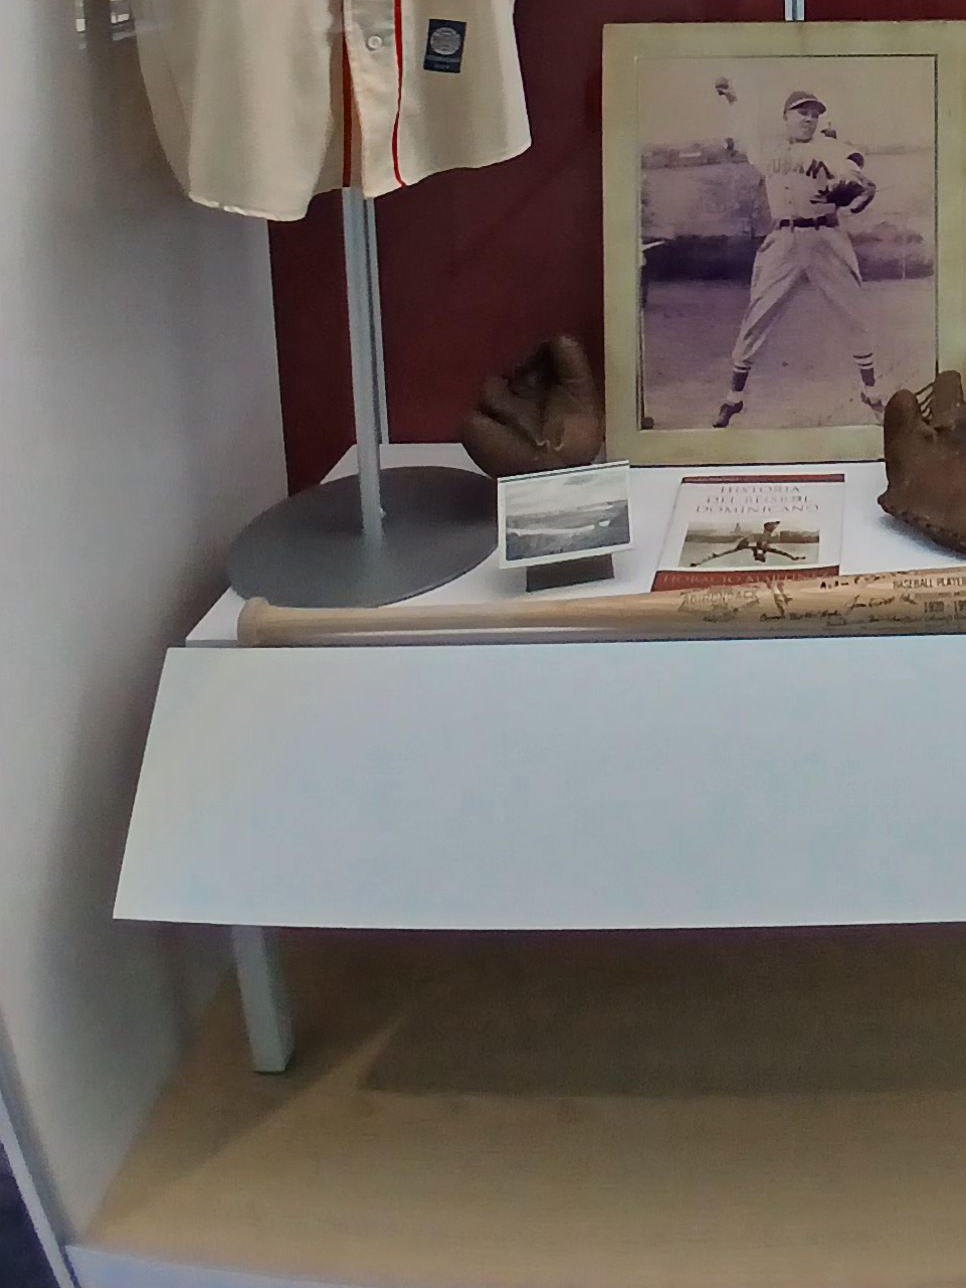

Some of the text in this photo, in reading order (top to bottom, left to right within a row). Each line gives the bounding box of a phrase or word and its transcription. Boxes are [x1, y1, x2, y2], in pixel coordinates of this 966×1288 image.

[720, 485, 801, 495] HISTORIA
[707, 496, 734, 504] DEL
[696, 504, 820, 513] DOMINICANO
[893, 578, 933, 589] BASEBALL
